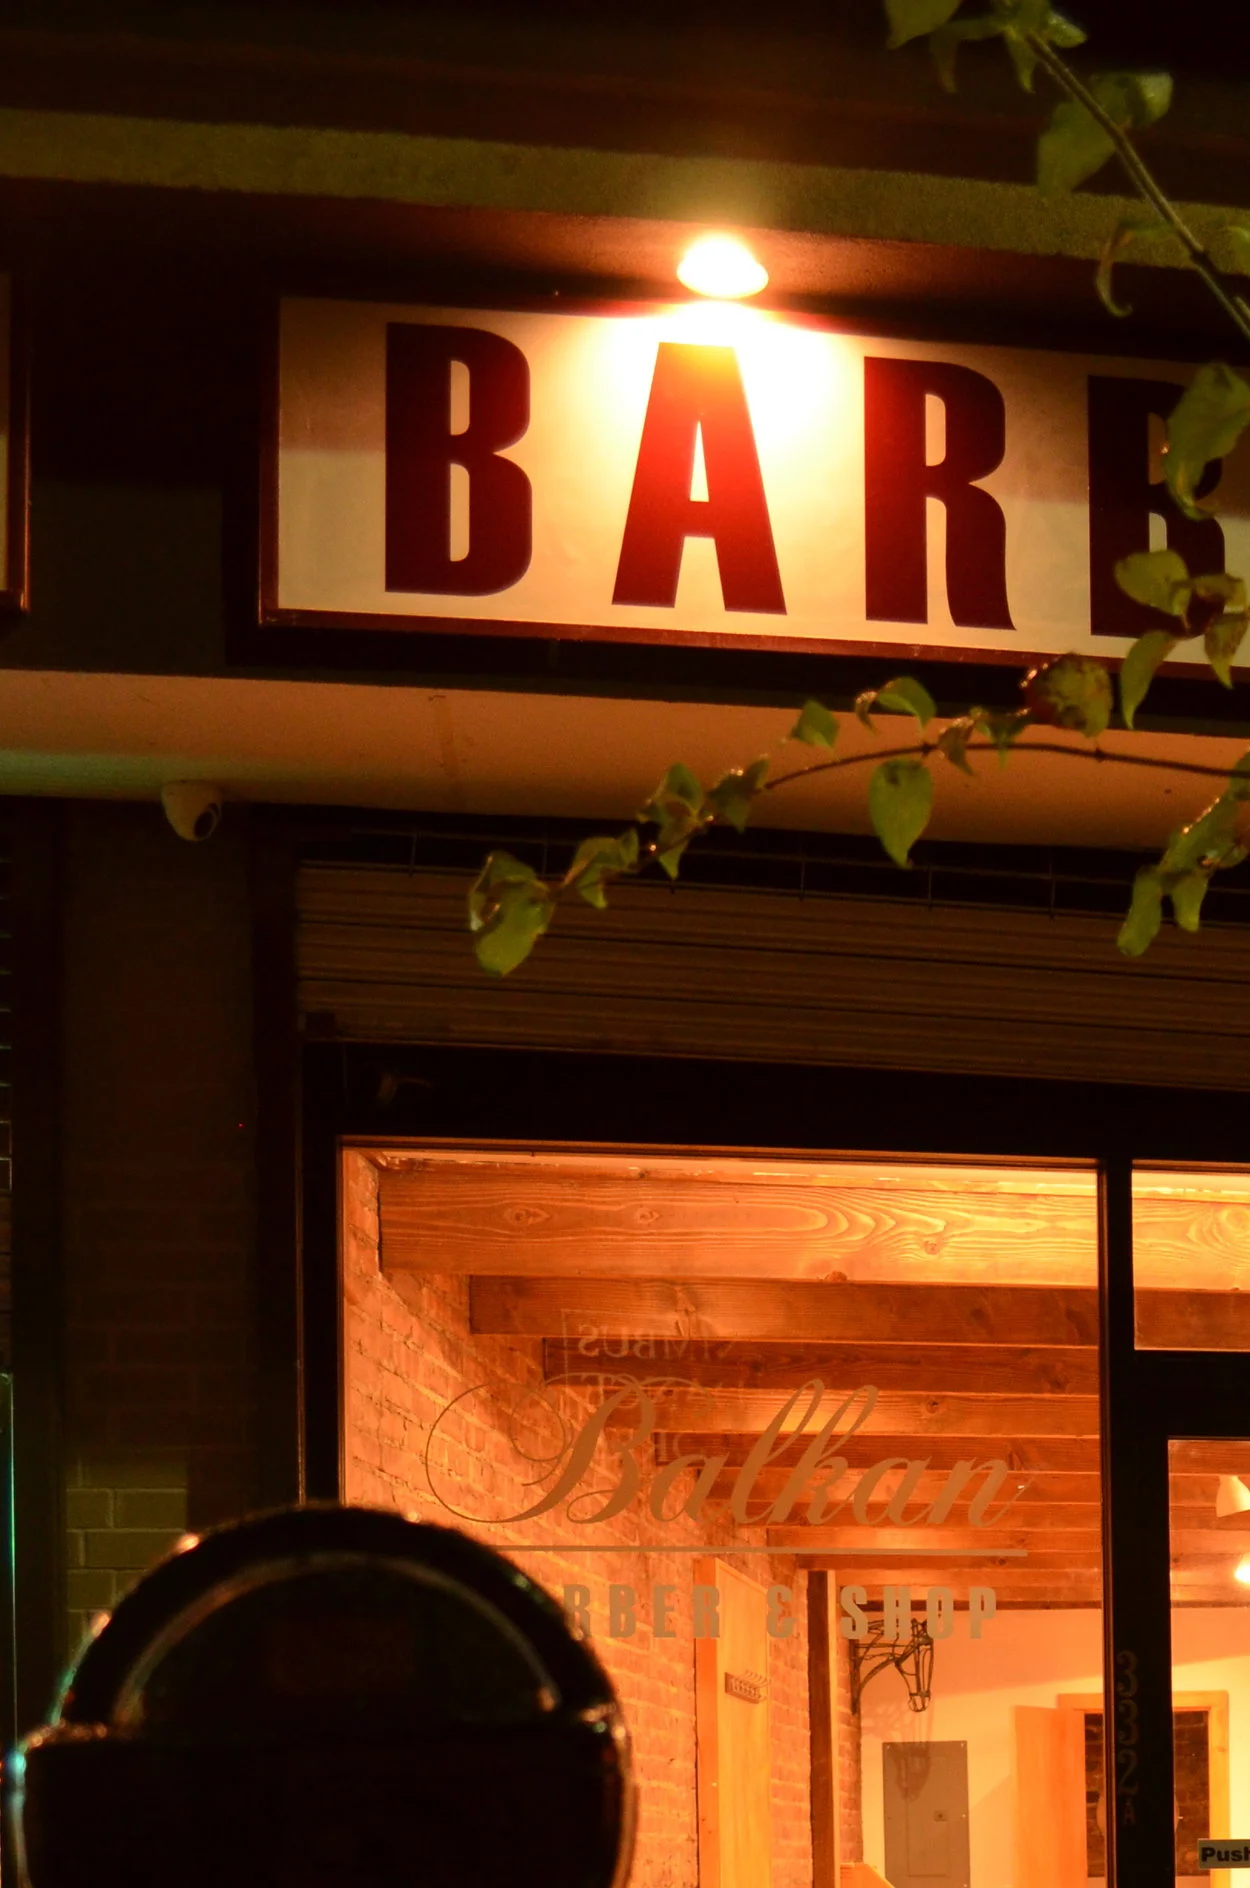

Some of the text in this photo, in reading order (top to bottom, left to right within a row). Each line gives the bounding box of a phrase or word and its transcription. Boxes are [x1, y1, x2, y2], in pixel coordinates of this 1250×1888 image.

[425, 1370, 1033, 1526] Balkan
[562, 1584, 998, 1640] RBER & SHOP
